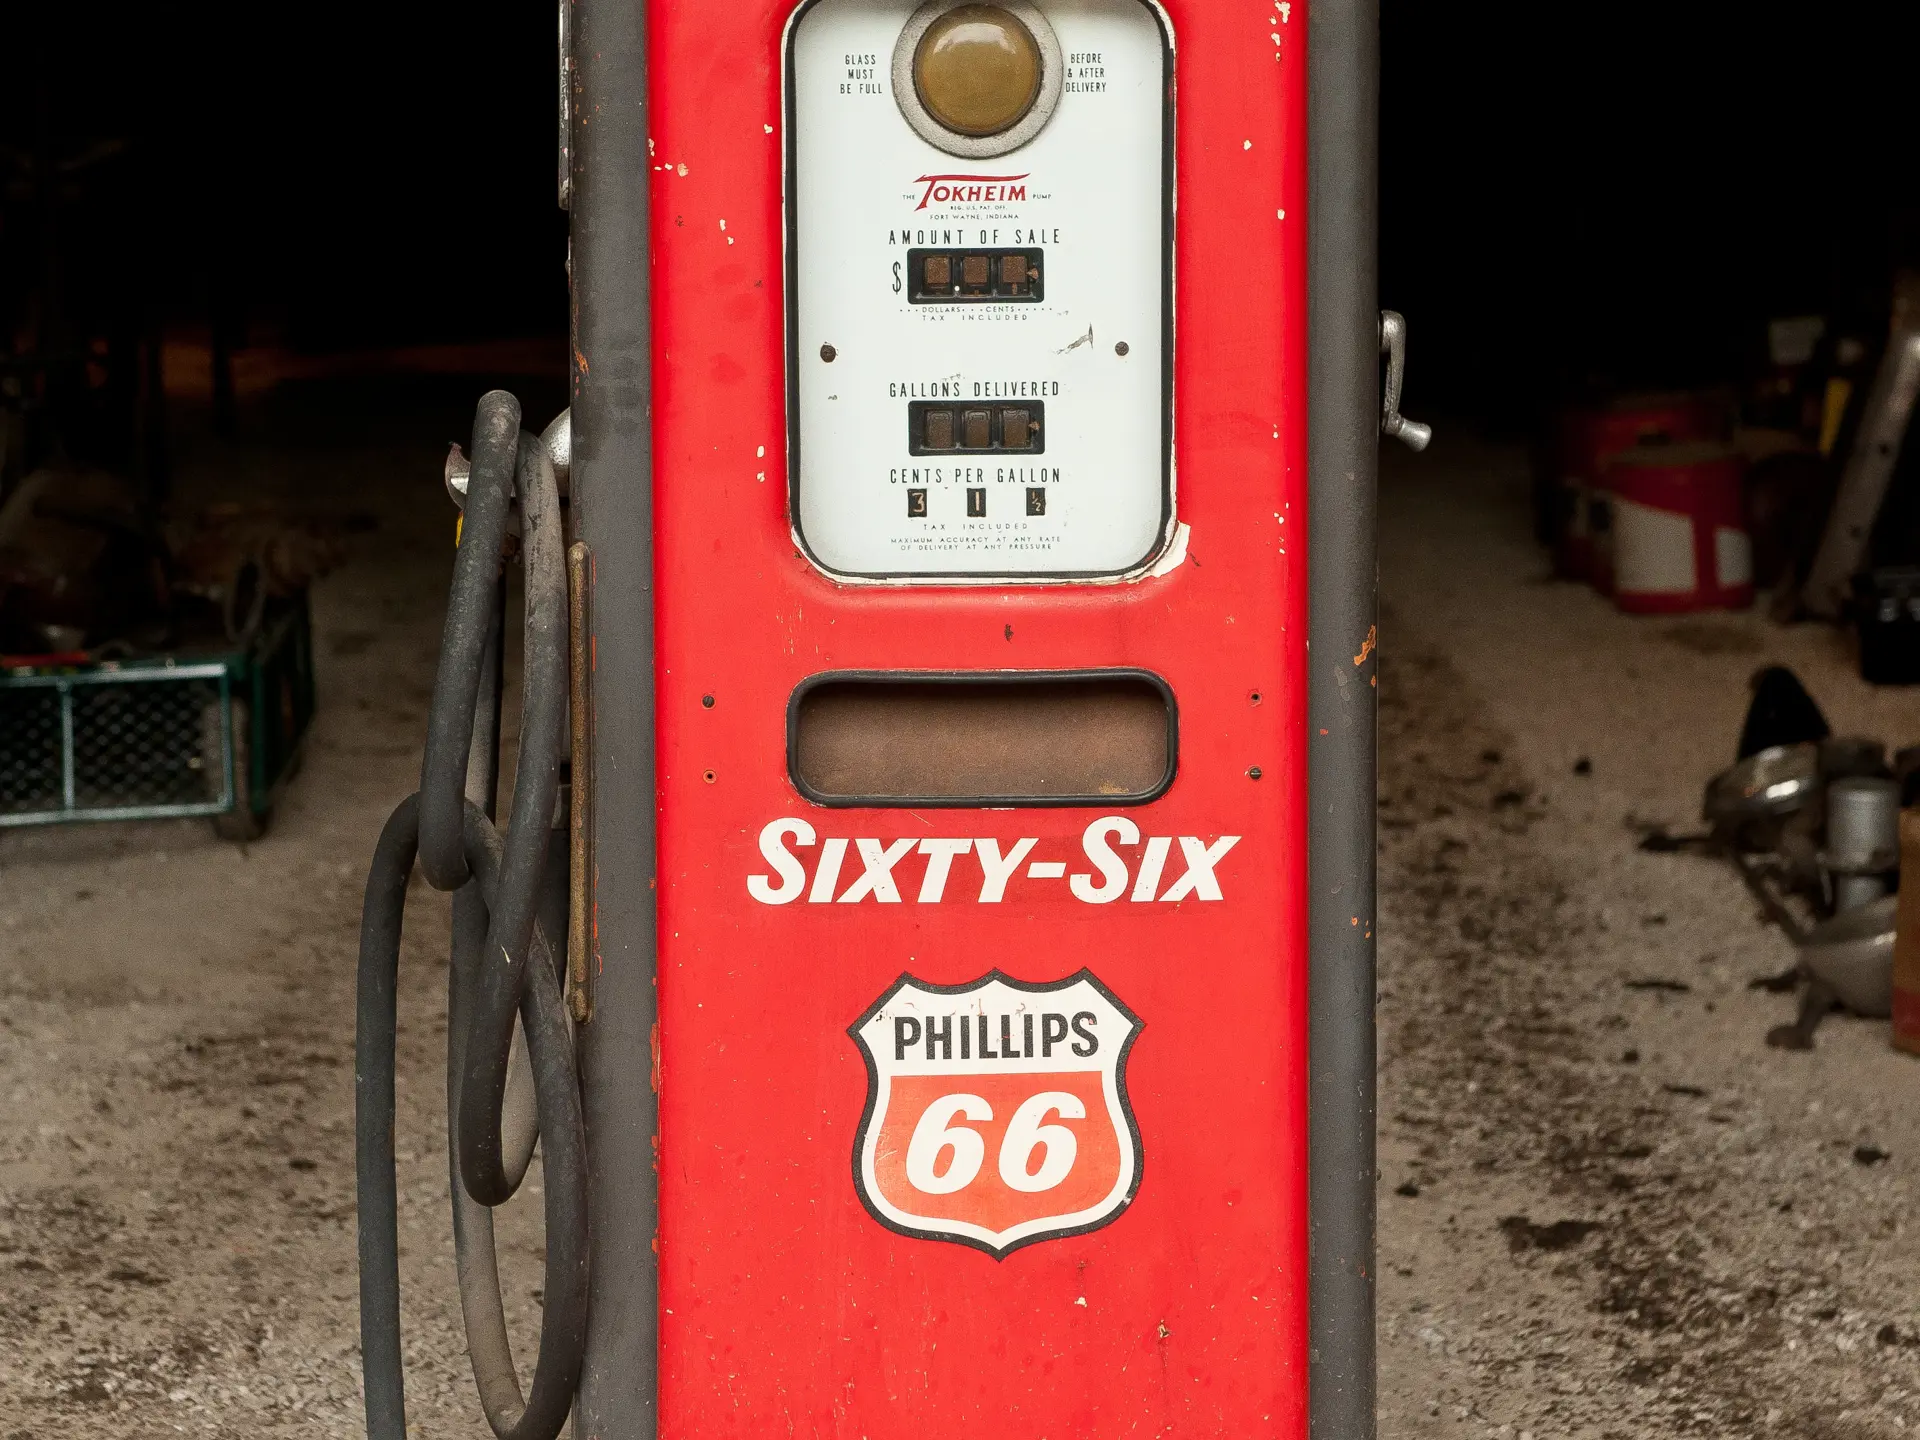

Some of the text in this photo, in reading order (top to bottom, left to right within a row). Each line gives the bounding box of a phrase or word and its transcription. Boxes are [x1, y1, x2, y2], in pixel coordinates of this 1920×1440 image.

[845, 54, 876, 65] GLASS
[1071, 54, 1102, 64] BEFORE
[848, 69, 874, 79] MUST
[1068, 68, 1105, 78] & AFTER
[840, 84, 882, 94] BE FULL
[1066, 82, 1106, 92] DELIVERY
[913, 173, 1031, 211] TOKHEIM
[889, 228, 1060, 245] AMOUNT OF SALE
[892, 261, 901, 295] $
[889, 382, 1059, 397] GALLONS DELIVERED
[890, 468, 1060, 484] CENTS PER GALLON
[912, 492, 925, 512] 3
[894, 1011, 1099, 1061] PHILLIPS
[904, 1092, 1087, 1195] 66
